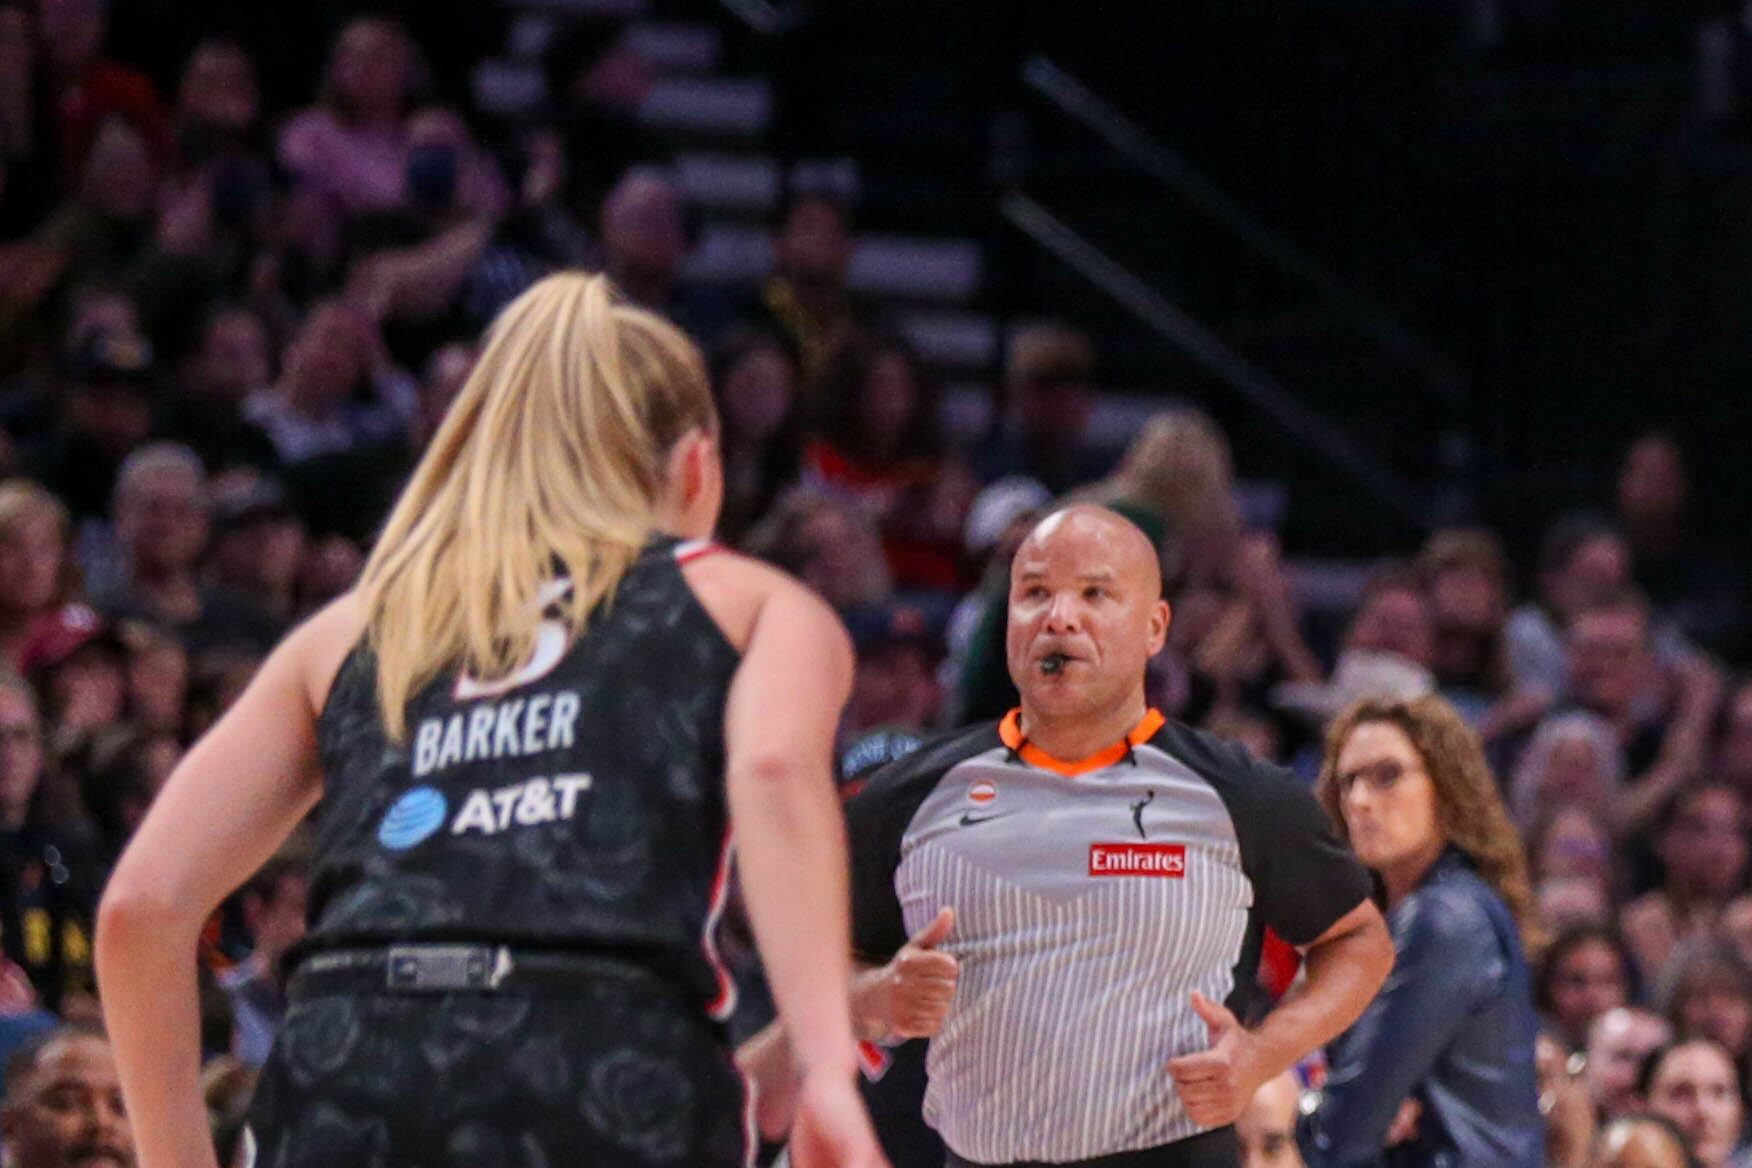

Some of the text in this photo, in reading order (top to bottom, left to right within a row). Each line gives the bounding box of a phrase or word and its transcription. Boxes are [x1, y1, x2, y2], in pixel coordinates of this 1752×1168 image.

[413, 692, 581, 776] BARKER
[451, 774, 592, 834] AT&T
[1093, 849, 1183, 872] Emirates
